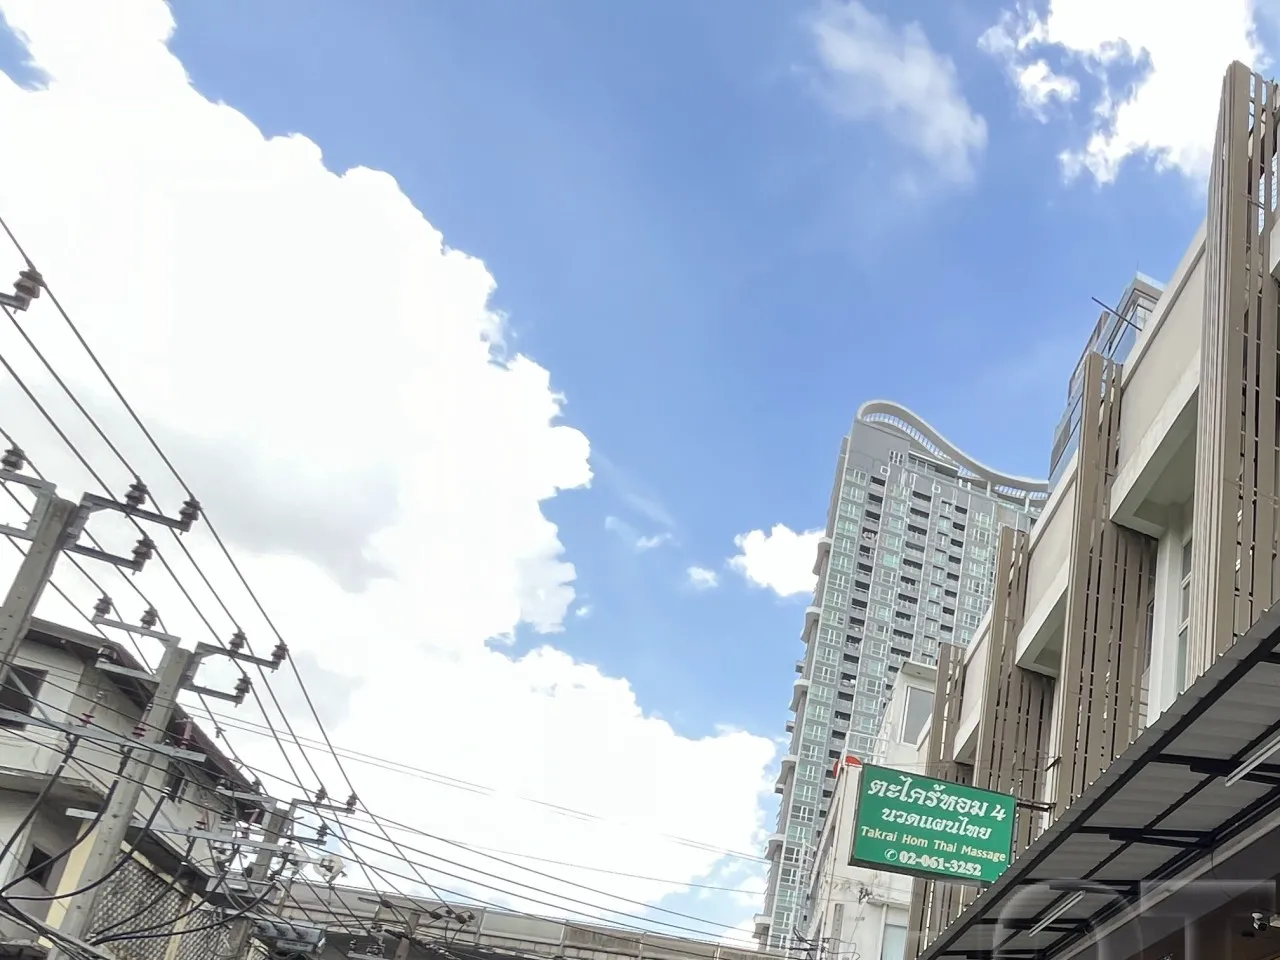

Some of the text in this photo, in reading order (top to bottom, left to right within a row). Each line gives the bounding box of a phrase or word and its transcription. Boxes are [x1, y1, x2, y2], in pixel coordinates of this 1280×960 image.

[867, 775, 988, 817] ตะไคร้หอม
[881, 807, 993, 840] นวดแผนไทย
[861, 826, 1006, 863] Takrai Hom Thai Massage
[899, 850, 982, 876] 02-061-3252
